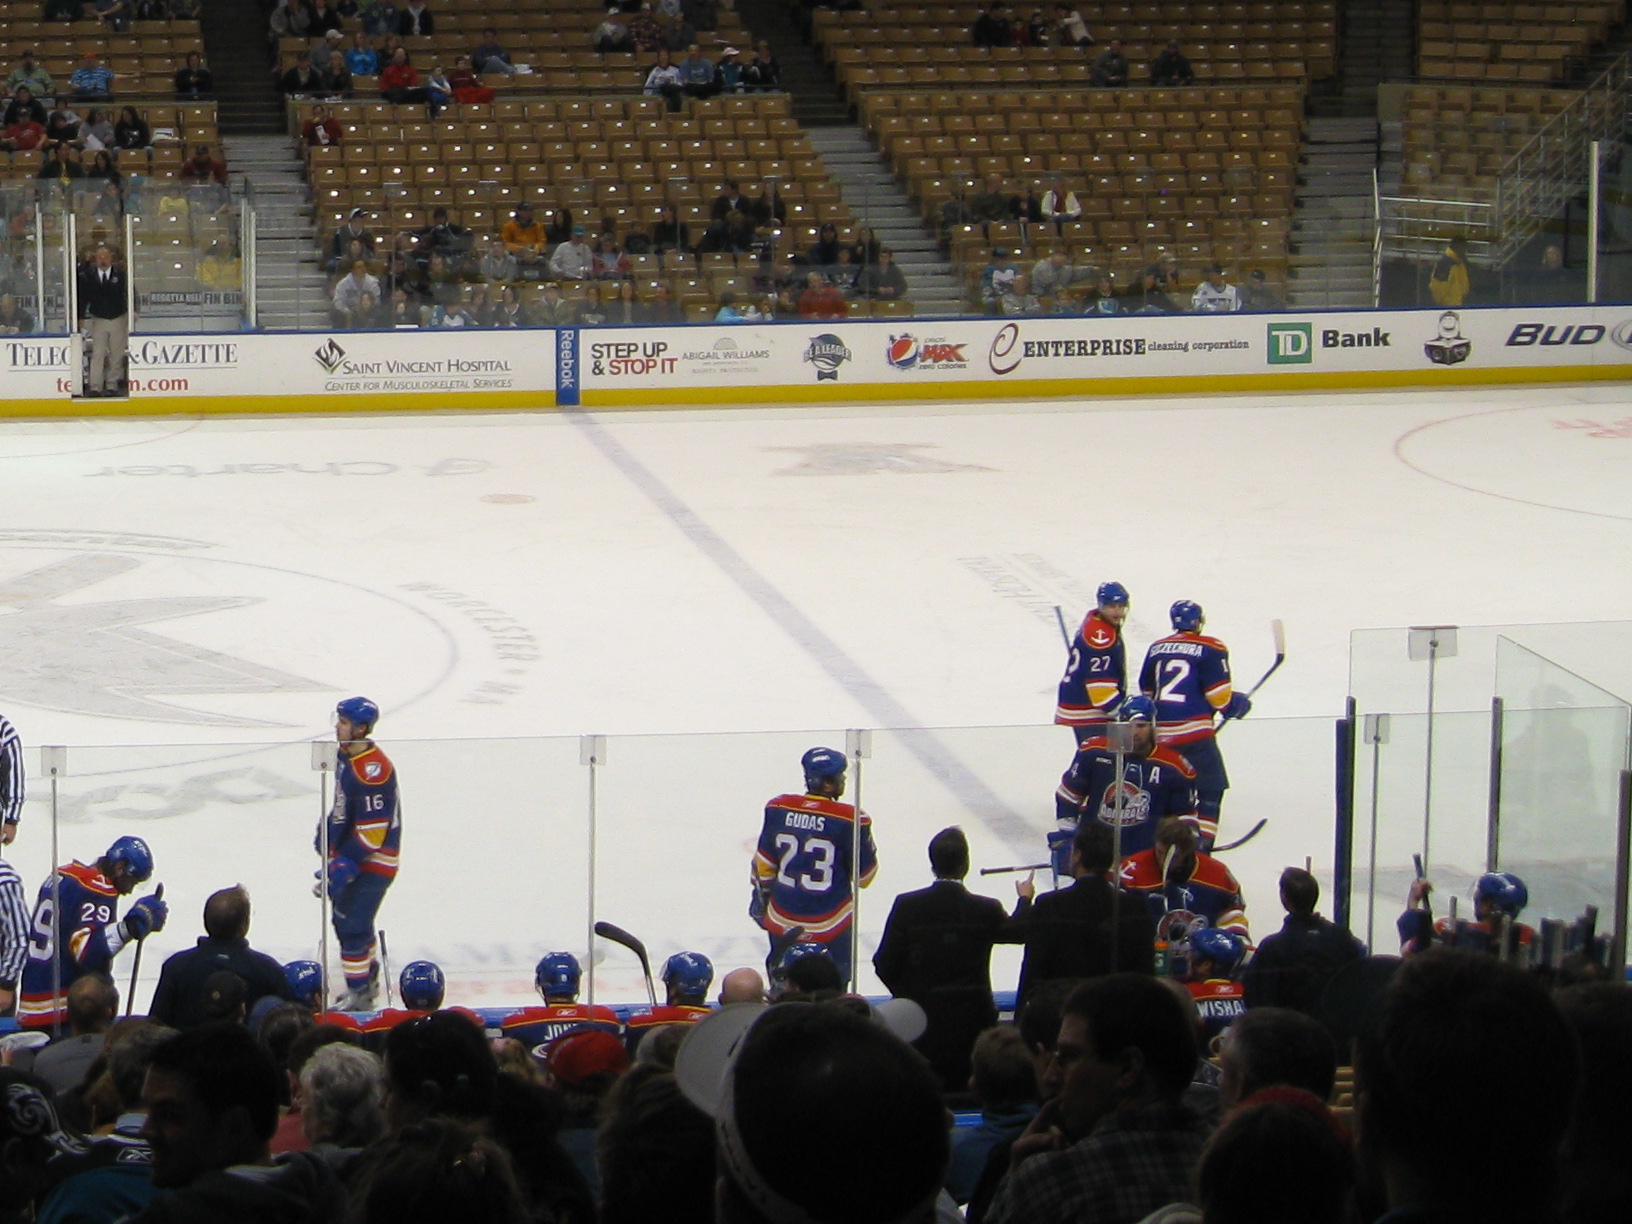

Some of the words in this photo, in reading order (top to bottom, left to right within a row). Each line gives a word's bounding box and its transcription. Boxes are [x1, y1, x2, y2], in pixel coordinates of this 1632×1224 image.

[204, 293, 222, 304] FIN
[1272, 330, 1307, 357] TD
[1322, 327, 1390, 348] Bank
[1506, 323, 1606, 345] BUD
[143, 340, 238, 364] GAZETTE
[592, 343, 639, 359] STEP
[643, 342, 668, 358] UP
[682, 352, 720, 361] ABIGAIL
[723, 350, 770, 359] WILLIAMS
[822, 343, 853, 361] LEADER
[920, 343, 968, 363] MAX
[1023, 338, 1146, 357] ENTERPRISE
[1148, 340, 1189, 352] cleaning
[1192, 339, 1249, 351] corporation
[343, 360, 381, 374] SAINT
[385, 360, 441, 374] VINCENT
[447, 359, 511, 372] HOSPITAL
[560, 329, 574, 389] Reebok
[592, 360, 605, 375] &
[609, 358, 657, 375] STOP
[661, 357, 678, 374] IT
[325, 380, 361, 392] CENTER
[363, 381, 380, 391] FOR
[383, 379, 470, 391] MUSCULOSKELETAL
[473, 378, 513, 389] SERVICES
[1090, 655, 1110, 672] 27
[1155, 659, 1191, 703] 12
[1149, 766, 1161, 785] A
[365, 794, 384, 812] 16
[785, 812, 826, 832] GUDAS
[775, 833, 836, 891] 23
[81, 902, 111, 923] 29
